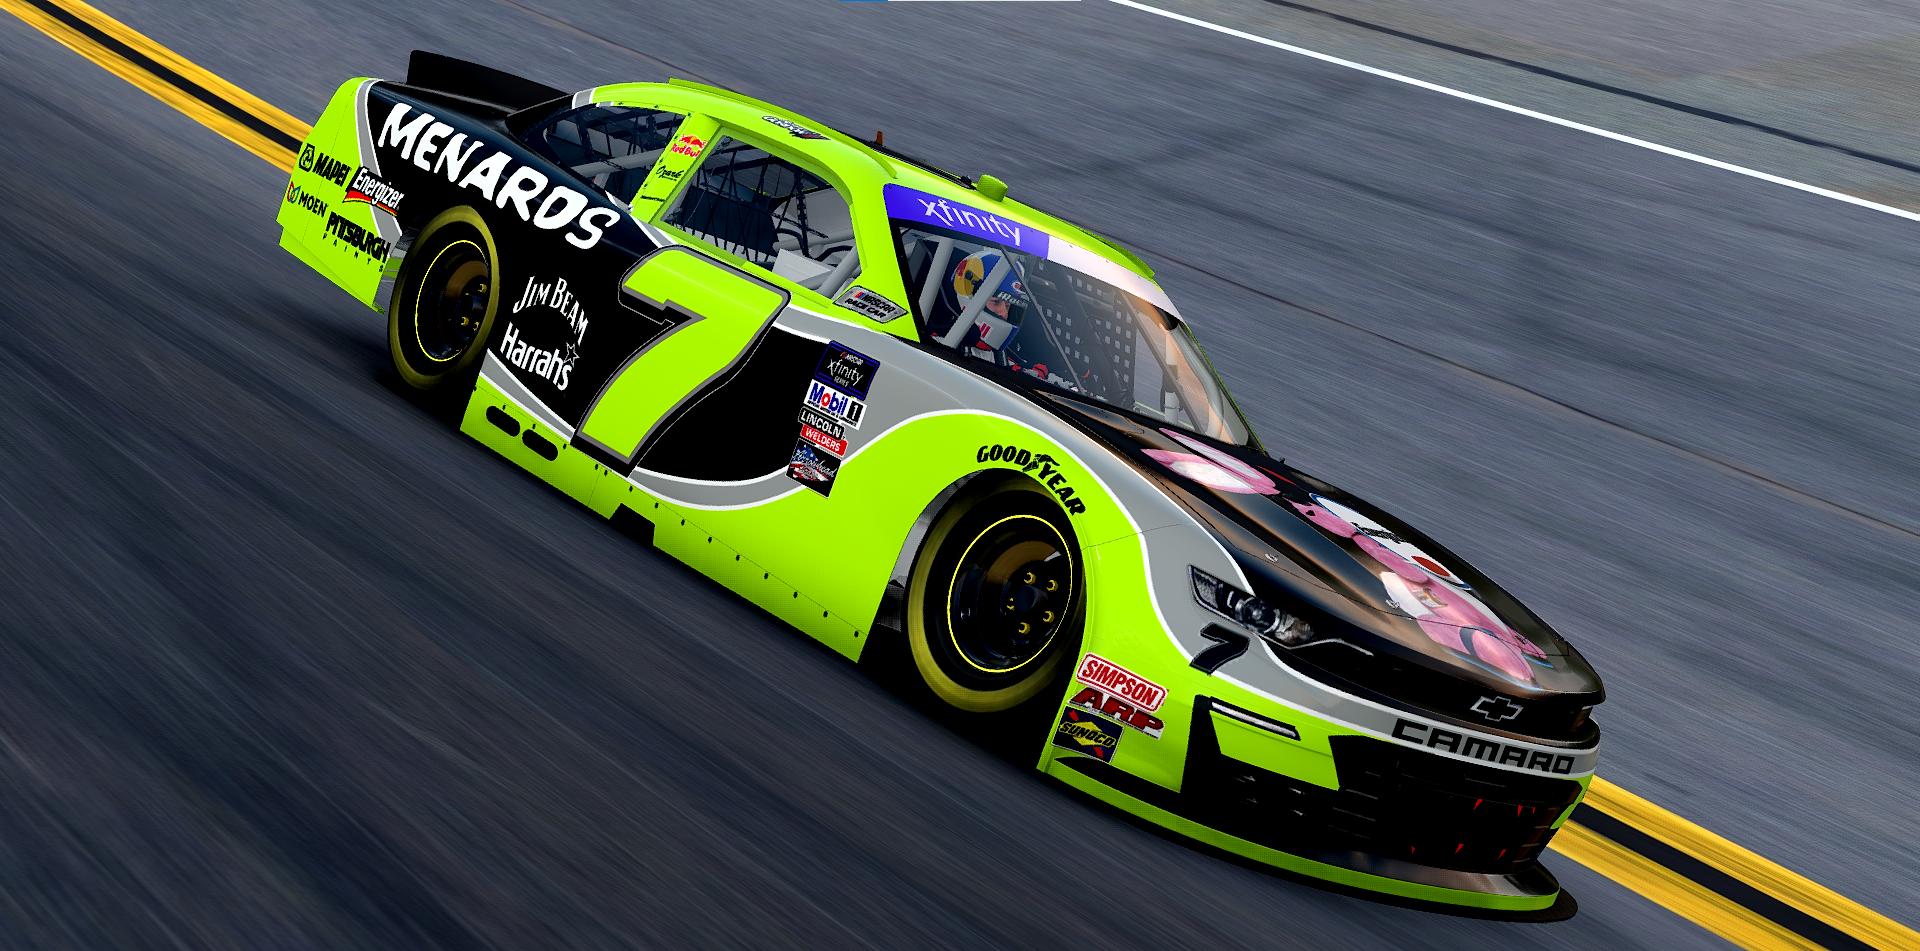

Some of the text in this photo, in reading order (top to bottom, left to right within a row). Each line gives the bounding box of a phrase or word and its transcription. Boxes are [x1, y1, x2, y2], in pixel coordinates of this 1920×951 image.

[671, 143, 701, 158] Red Bul
[312, 152, 351, 187] MAPEI
[351, 167, 404, 205] Energizer
[378, 103, 620, 250] MENARDS
[298, 190, 329, 218] MOEN
[325, 211, 391, 264] PITTSBURGH
[918, 198, 1020, 247] xfinity
[512, 275, 589, 347] JIM BEAM
[844, 297, 887, 319] RACE CAR
[860, 293, 896, 313] NASCAR
[571, 245, 791, 476] 7
[826, 358, 864, 387] xfinity
[808, 382, 849, 416] Mobil
[800, 410, 842, 438] LINCOLN
[805, 427, 841, 452] WELDERS
[1190, 622, 1250, 675] 7
[1082, 659, 1160, 706] SIMPSON
[1070, 687, 1165, 732] ARP
[1059, 721, 1117, 748] SUNOCO
[1391, 717, 1576, 775] CAMARO
